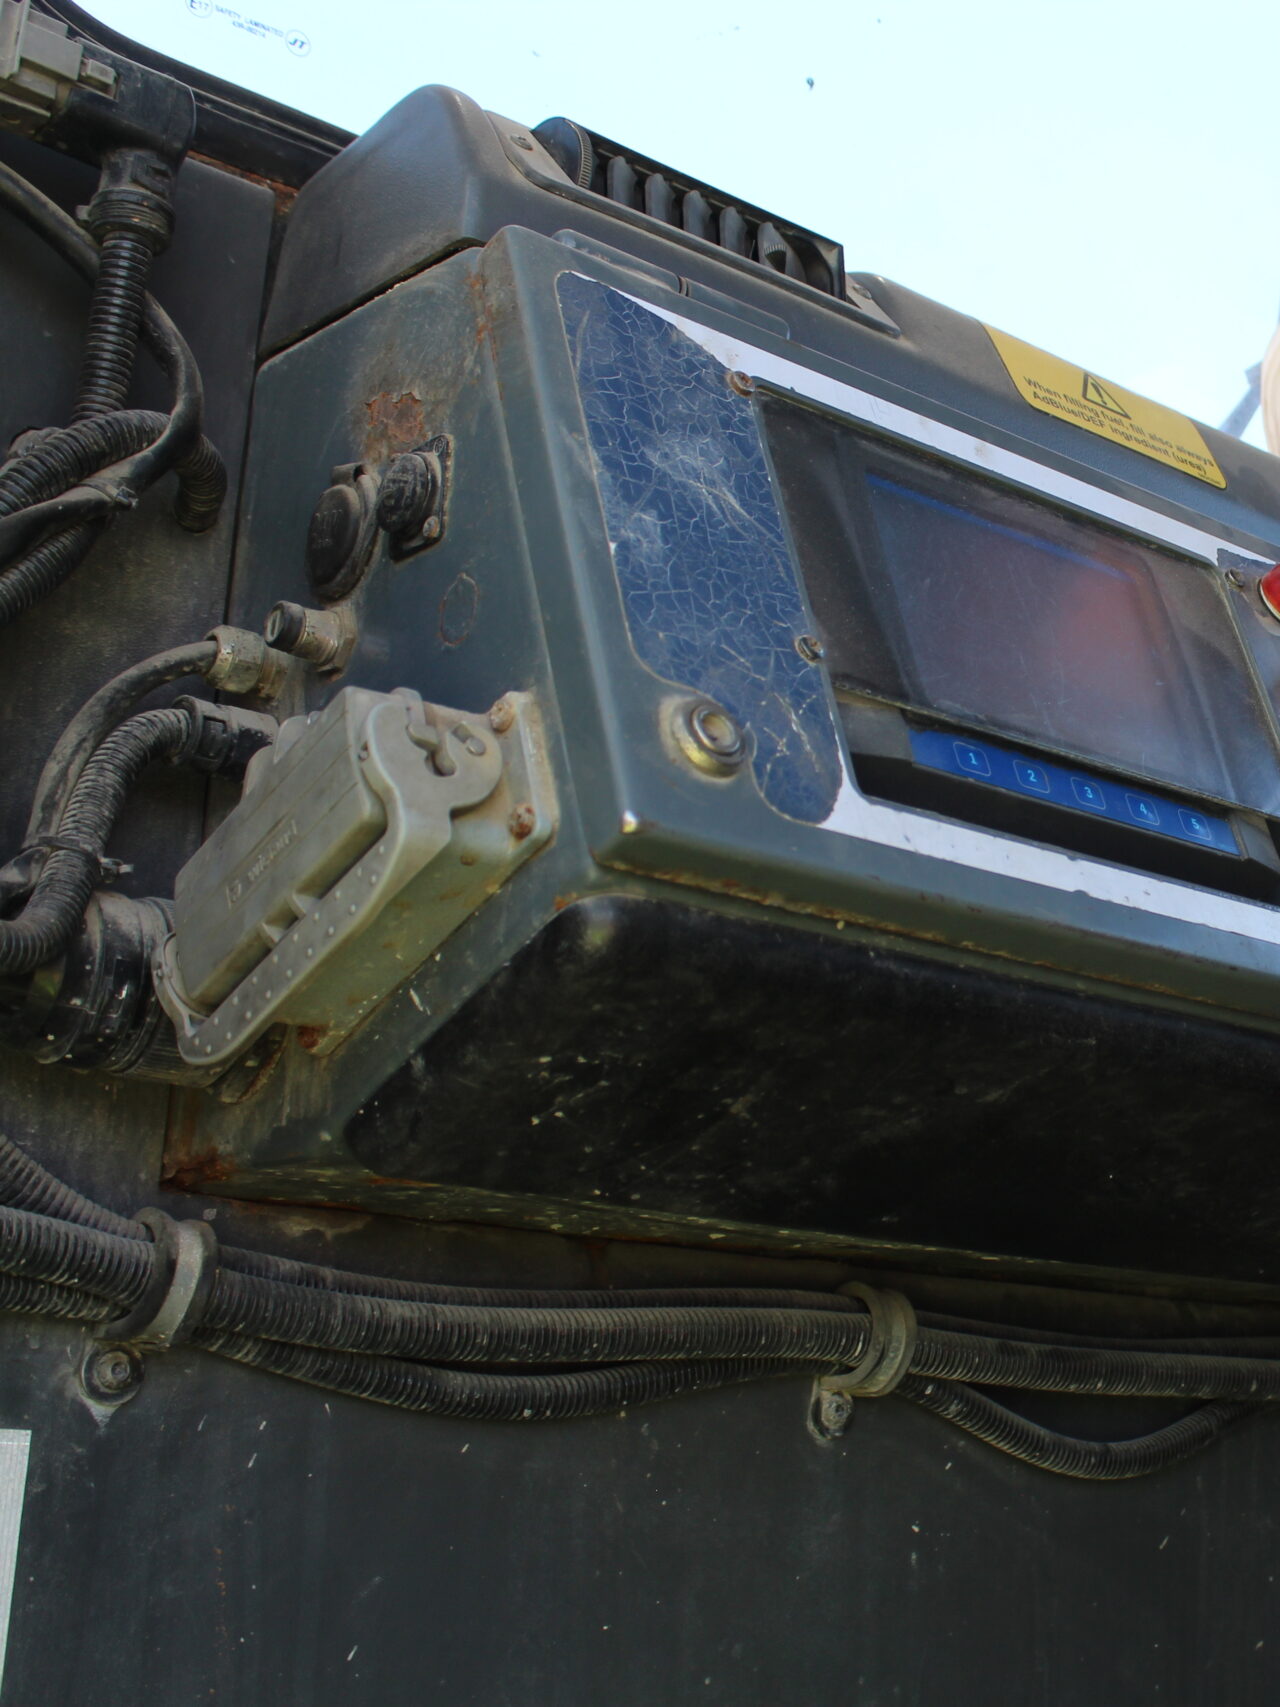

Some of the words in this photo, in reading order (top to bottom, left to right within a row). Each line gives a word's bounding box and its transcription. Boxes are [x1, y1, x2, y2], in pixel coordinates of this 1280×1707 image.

[1022, 375, 1062, 400] When
[1063, 391, 1100, 417] filling
[1130, 419, 1145, 436] fill
[1175, 440, 1216, 468] always
[1032, 390, 1106, 429] AdBlue/DEF
[1110, 421, 1172, 458] ingredient
[1174, 451, 1208, 476] (urea)
[968, 752, 978, 765] 1
[1027, 769, 1037, 782] 2
[1083, 786, 1093, 799] 3
[1139, 802, 1148, 815] 4
[1190, 817, 1200, 831] 5
